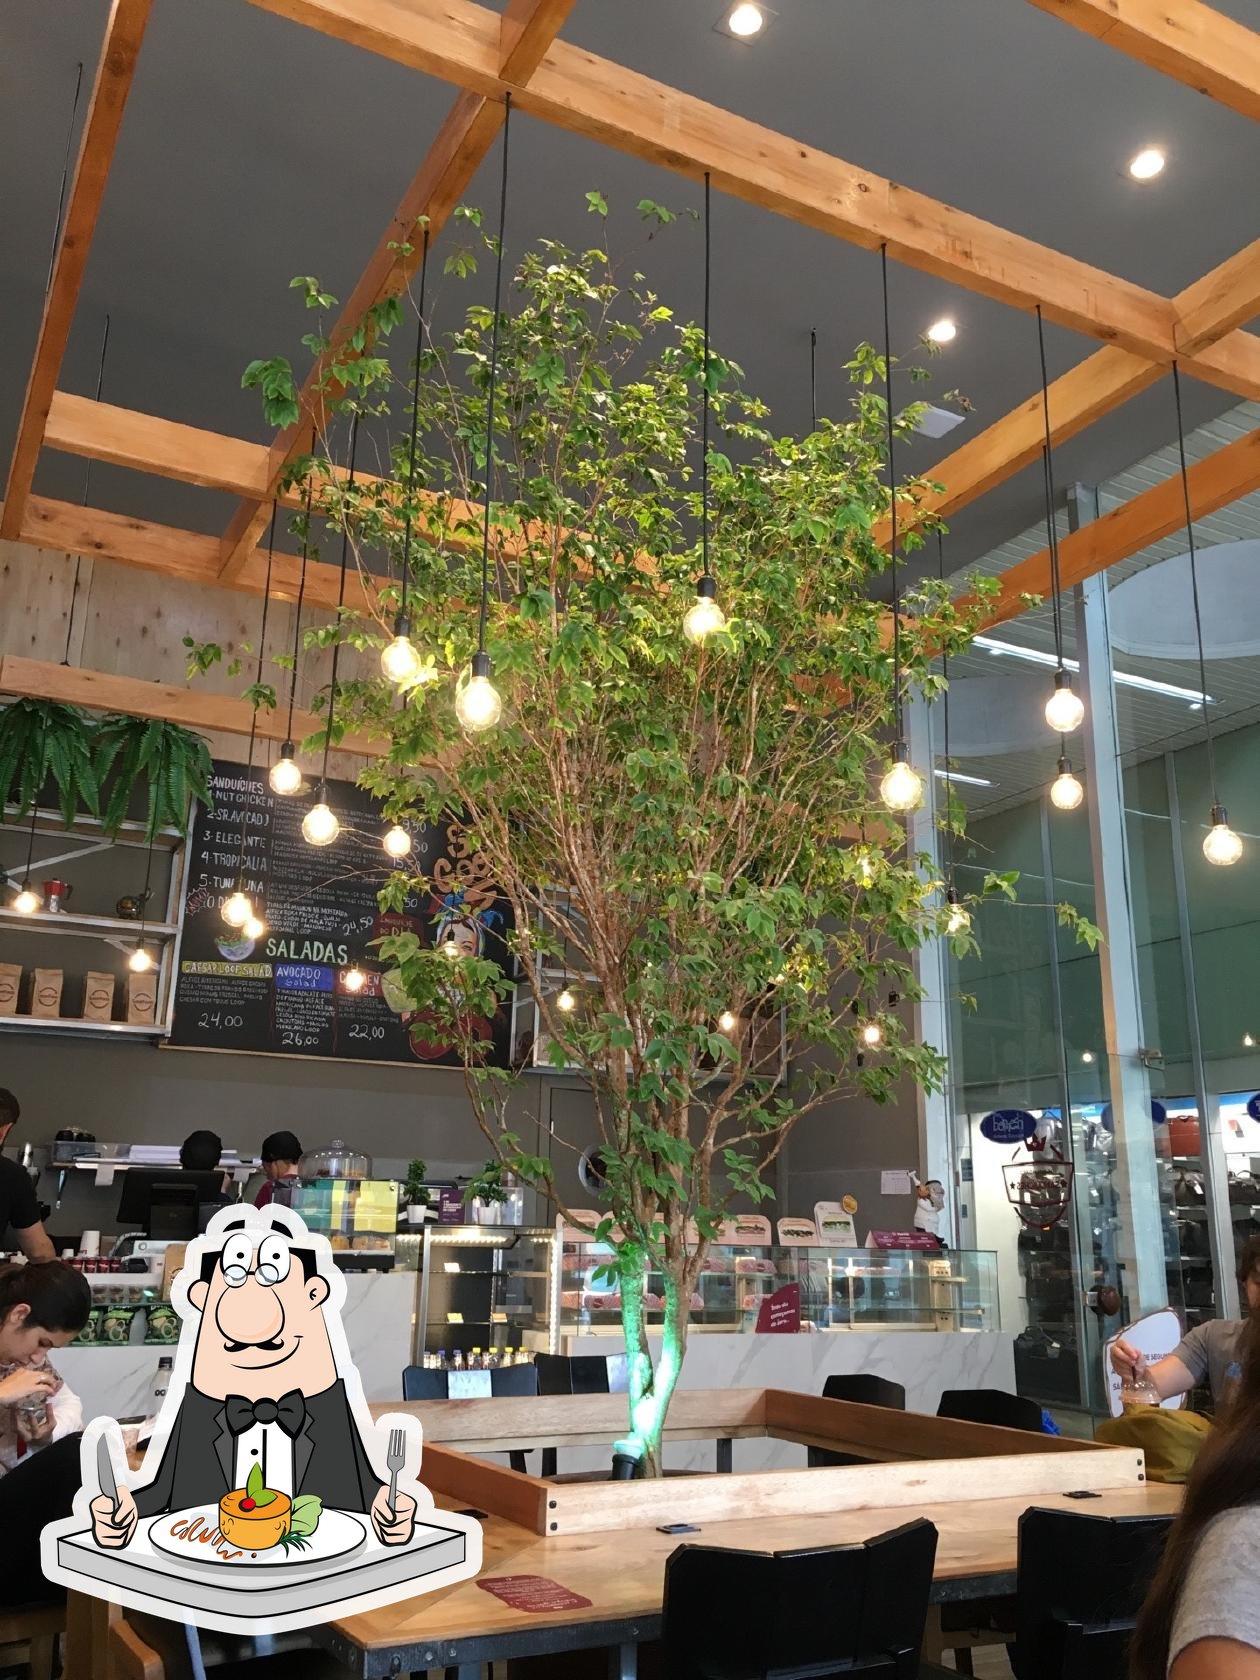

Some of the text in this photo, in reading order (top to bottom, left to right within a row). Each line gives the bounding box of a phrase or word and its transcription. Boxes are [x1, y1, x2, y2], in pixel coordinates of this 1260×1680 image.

[342, 916, 373, 936] 24,50
[266, 938, 348, 966] SALADAS
[276, 966, 321, 980] AVOCADO
[198, 1012, 244, 1030] 24,00
[282, 1032, 319, 1047] 26,00
[348, 1024, 385, 1040] 22,00
